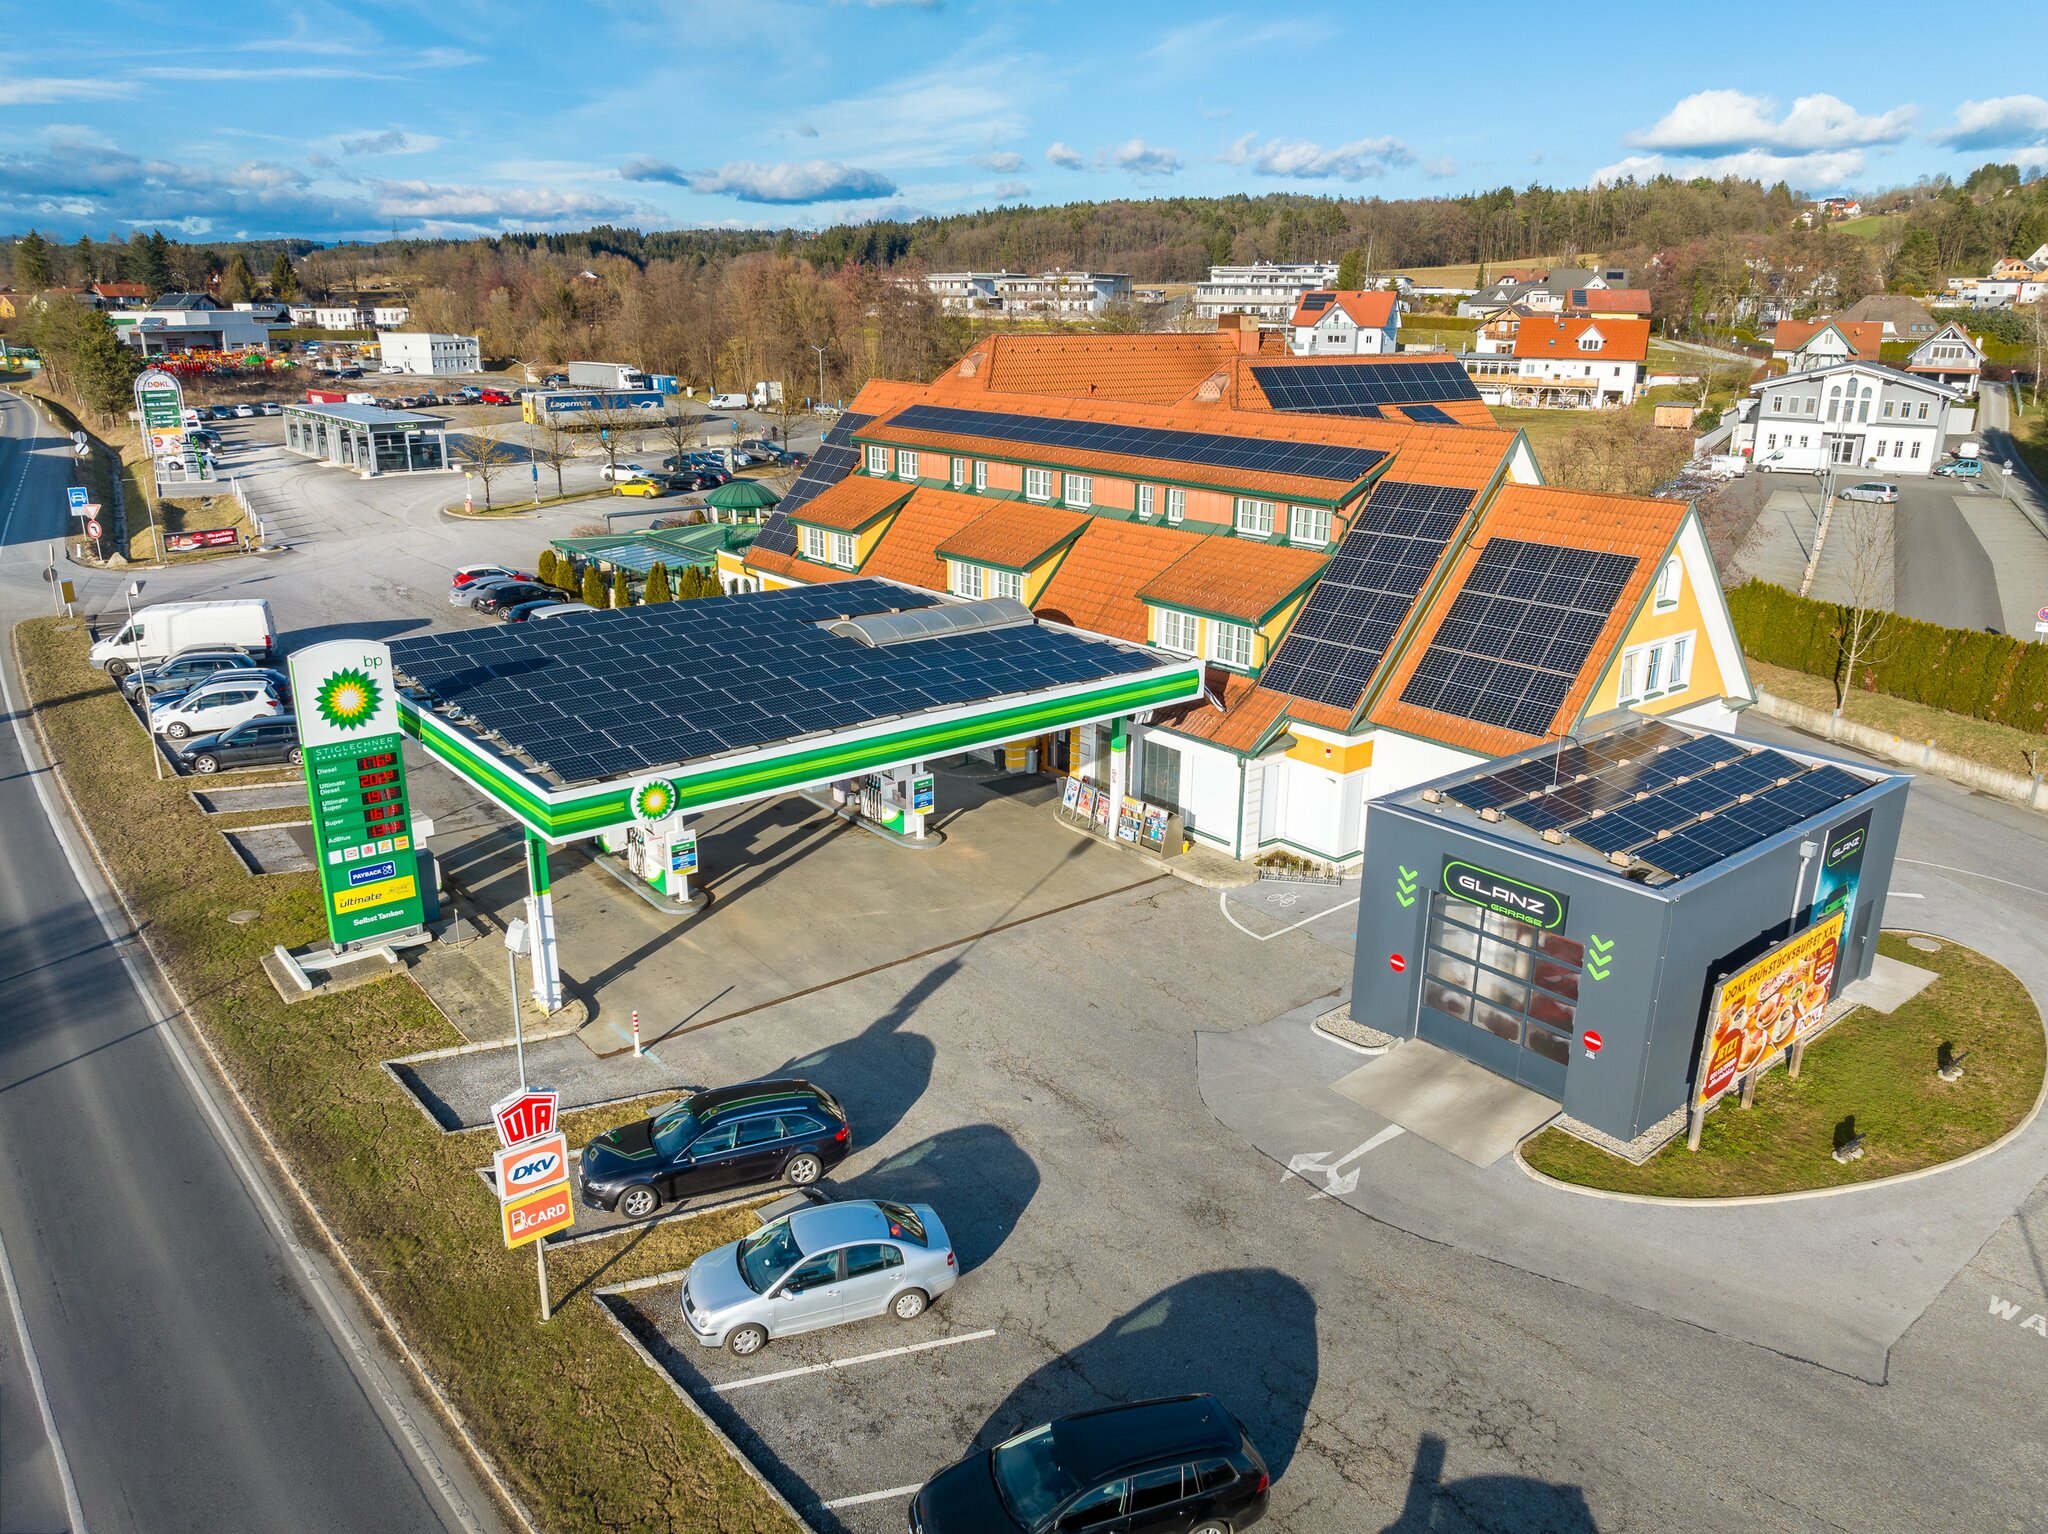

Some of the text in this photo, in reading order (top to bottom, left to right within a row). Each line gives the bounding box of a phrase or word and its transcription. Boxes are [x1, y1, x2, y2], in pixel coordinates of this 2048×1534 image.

[550, 400, 592, 409] Lagermax
[363, 655, 383, 669] bp
[317, 766, 338, 775] Diesel
[319, 780, 346, 789] Ultimate
[320, 787, 340, 795] Diesel
[322, 797, 349, 806] Ultimate
[322, 804, 342, 812] Super
[324, 818, 344, 827] Super
[328, 835, 351, 844] AdBlue
[353, 868, 382, 880] PAYBACK
[1458, 875, 1546, 915] GLANZ
[353, 909, 404, 926] Selbst Tanken
[1490, 903, 1543, 927] GARAGE
[1725, 983, 1746, 1002] DOKL
[1748, 932, 1822, 986] FRÜHSTÜCKSBUFFET
[1822, 923, 1838, 942] XXL
[1797, 1009, 1821, 1031] DOKL
[501, 1097, 552, 1143] UTA
[512, 1155, 556, 1181] DKV
[527, 1203, 566, 1227] CARD
